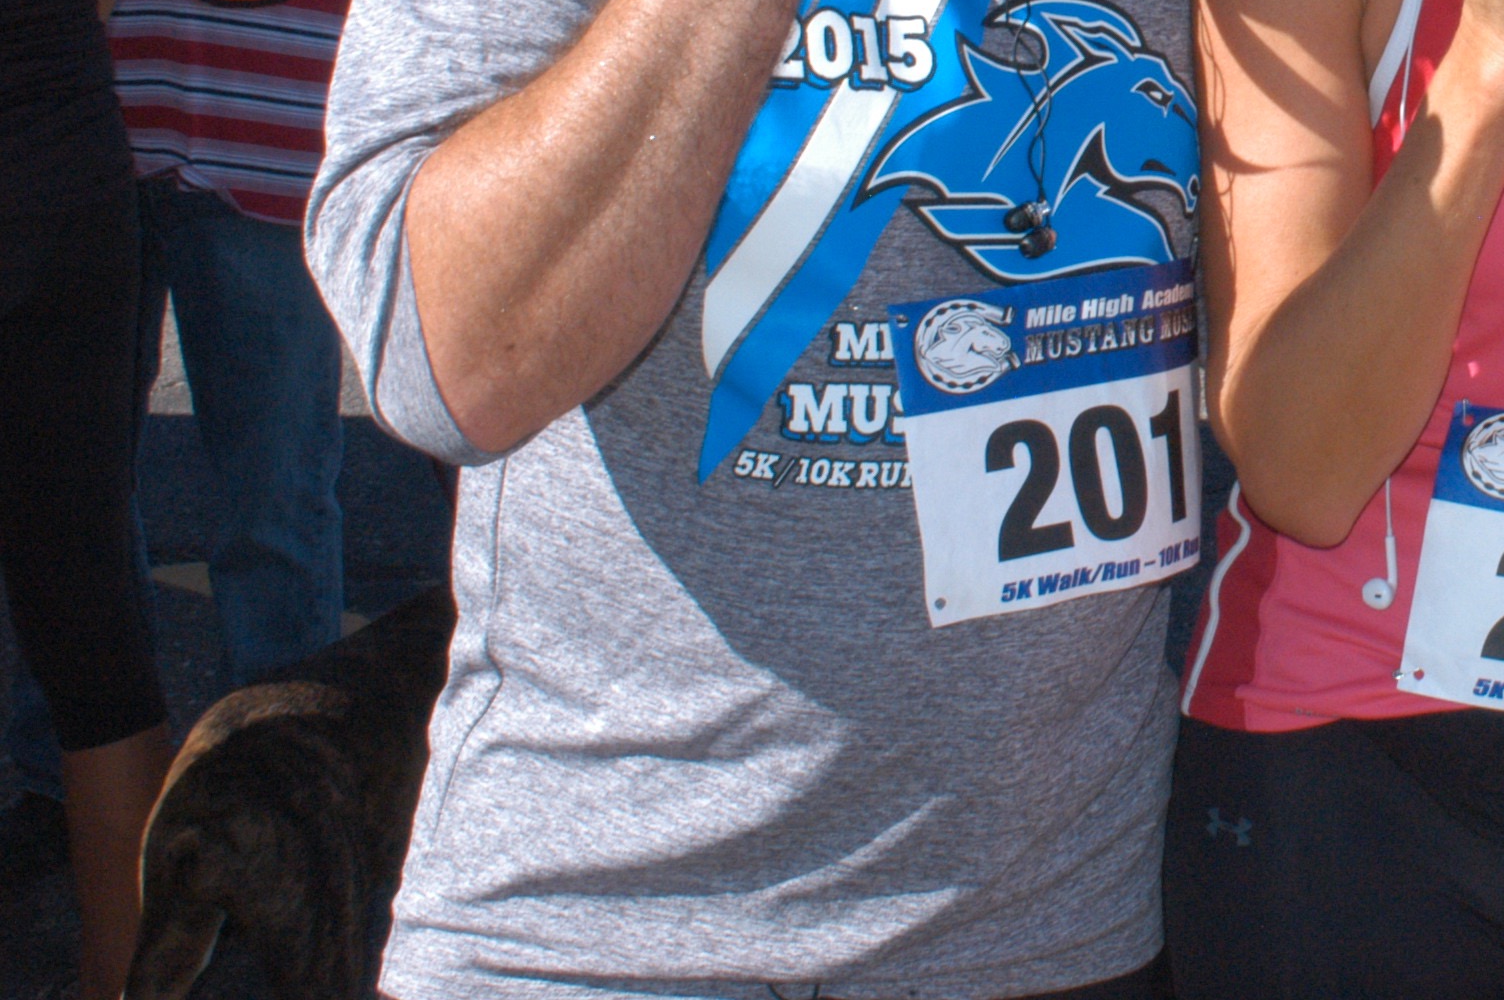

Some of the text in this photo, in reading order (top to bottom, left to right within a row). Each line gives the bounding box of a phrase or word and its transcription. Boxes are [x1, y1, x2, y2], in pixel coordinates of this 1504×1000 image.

[772, 9, 935, 84] 2015
[1025, 283, 1194, 329] Mile High Academ
[1024, 317, 1155, 364] MUSTANG
[985, 390, 1187, 563] 201
[1001, 578, 1032, 603] 5K
[1038, 558, 1140, 597] Walk/Run
[1159, 543, 1182, 567] 10K
